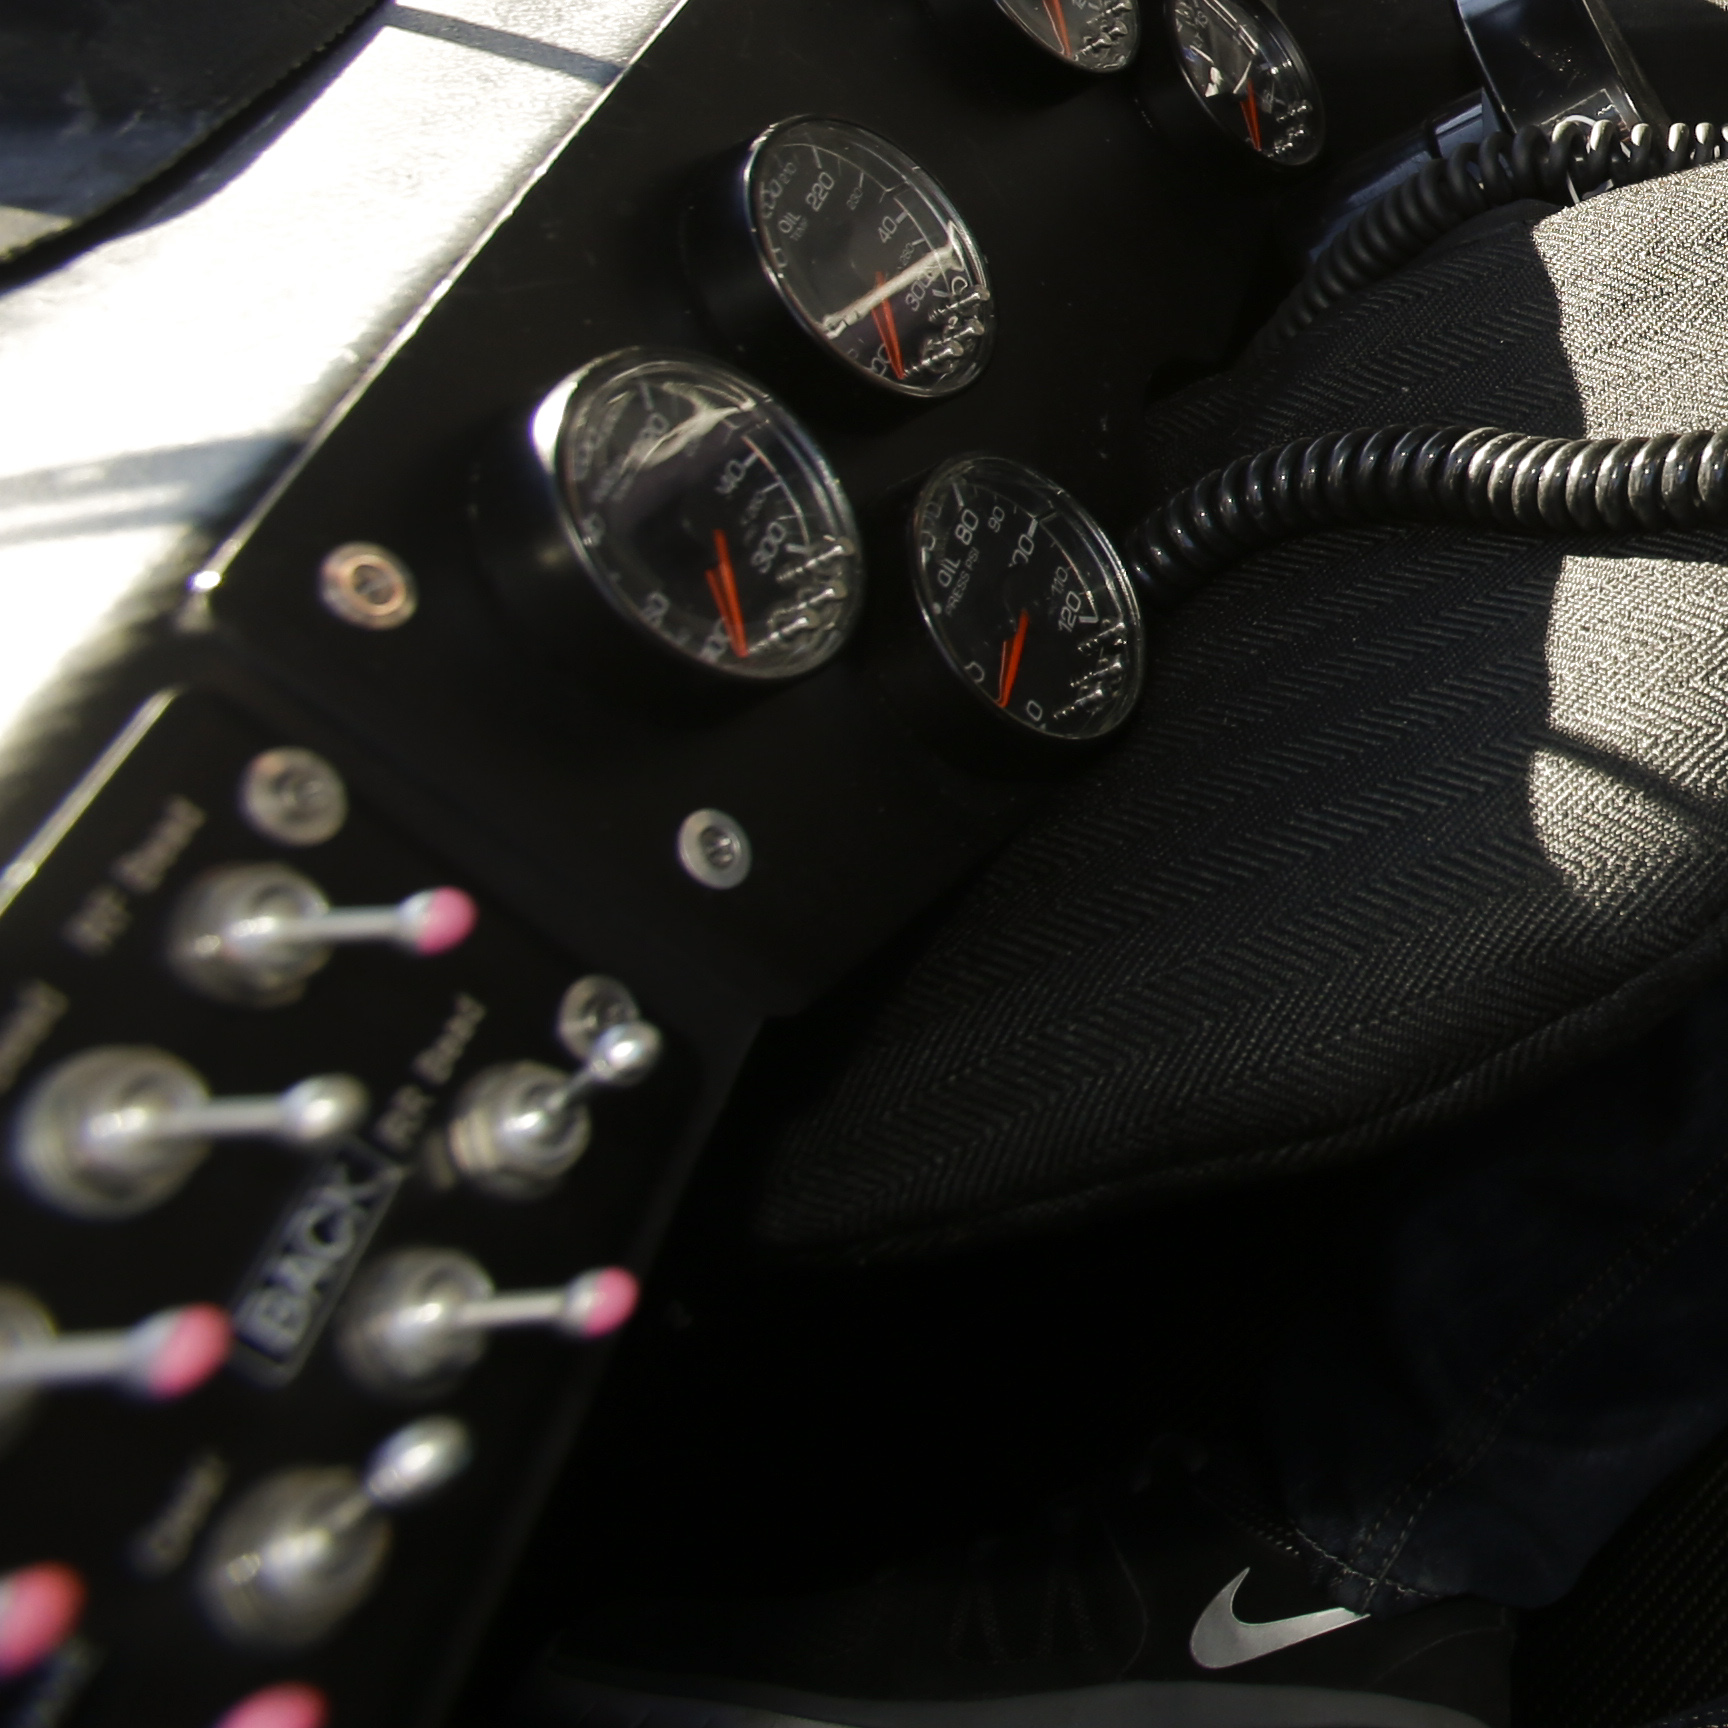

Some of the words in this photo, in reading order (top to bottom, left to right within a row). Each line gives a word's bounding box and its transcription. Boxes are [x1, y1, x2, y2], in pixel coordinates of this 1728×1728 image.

[805, 172, 835, 213] 220
[777, 211, 801, 235] OIL
[954, 508, 979, 546] 80
[987, 505, 1006, 534] 90
[937, 557, 961, 589] OIL
[965, 546, 980, 571] PSI
[1058, 590, 1082, 633] 120
